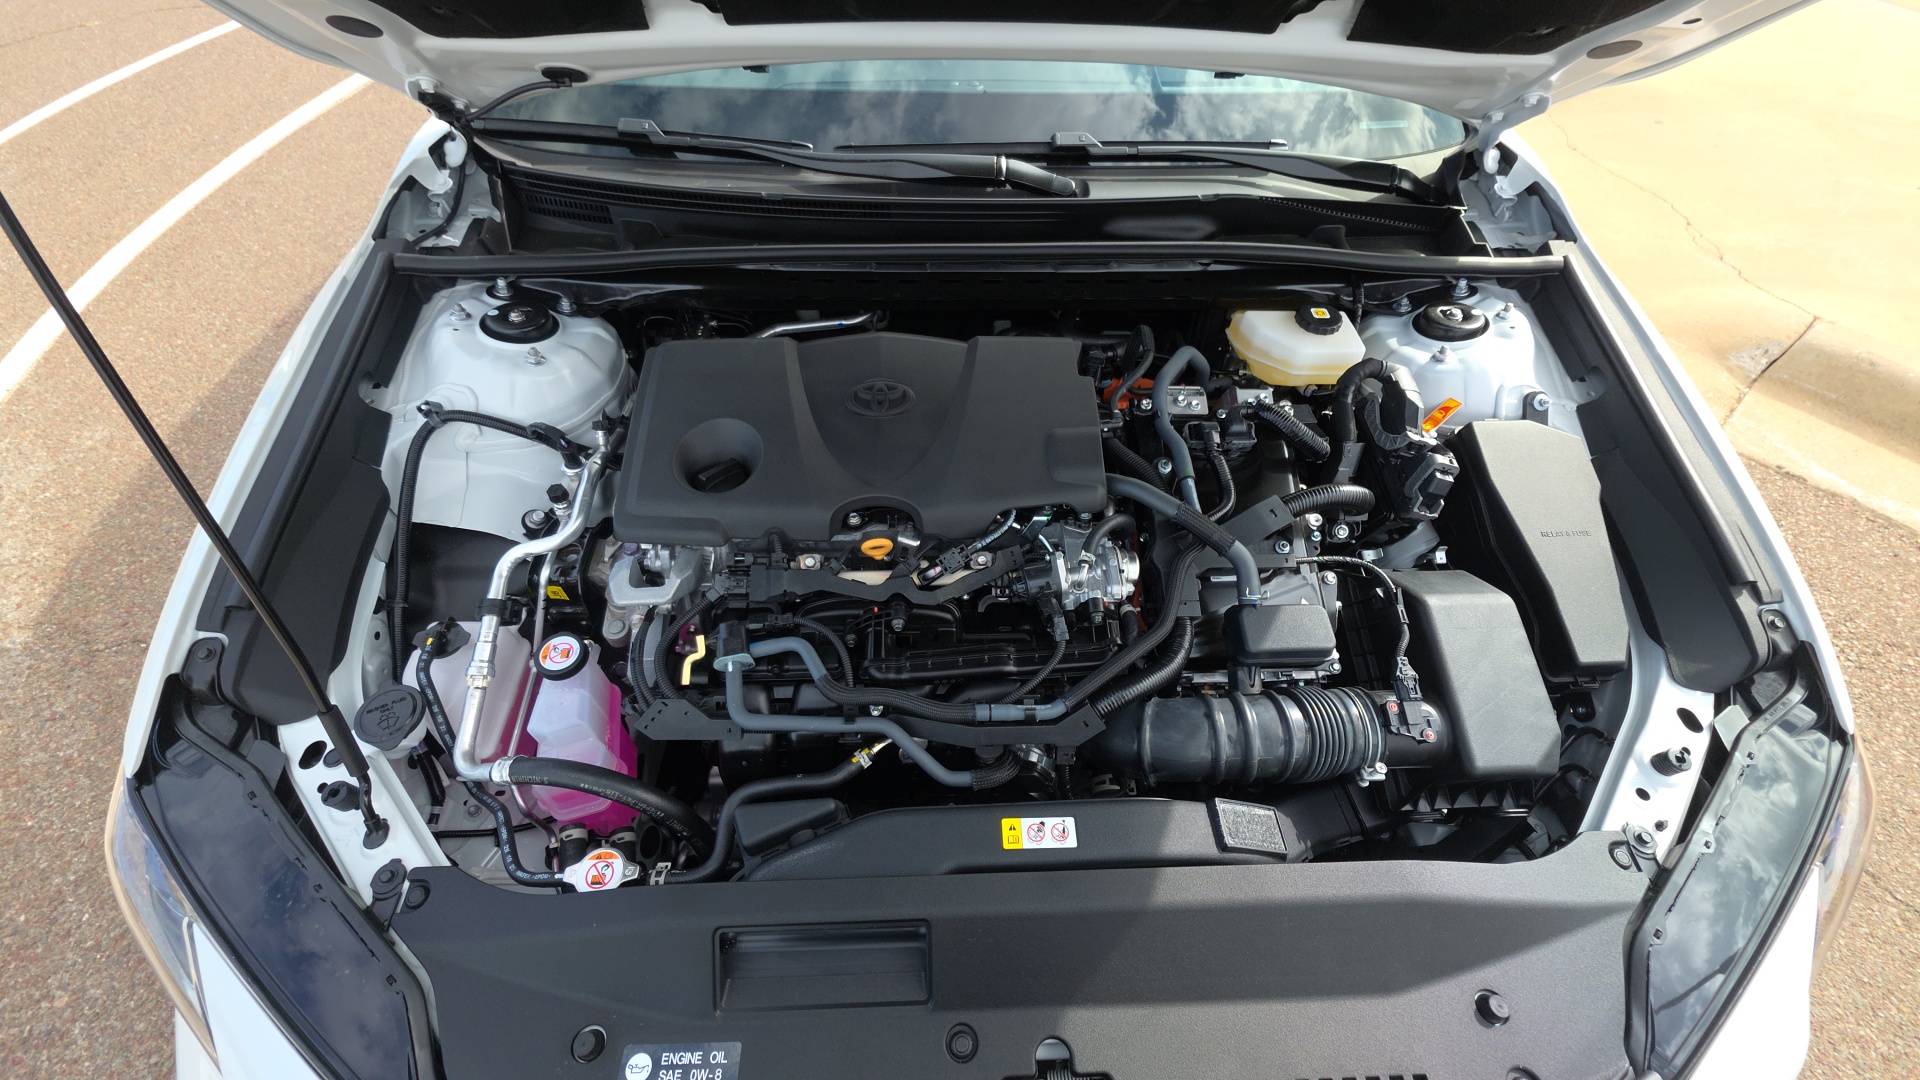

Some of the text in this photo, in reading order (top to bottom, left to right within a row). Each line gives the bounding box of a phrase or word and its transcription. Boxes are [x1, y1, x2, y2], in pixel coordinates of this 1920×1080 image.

[1572, 529, 1591, 537] FUSE
[661, 1051, 728, 1066] ENGINE OIL
[658, 1068, 723, 1080] SAE 0W-8
